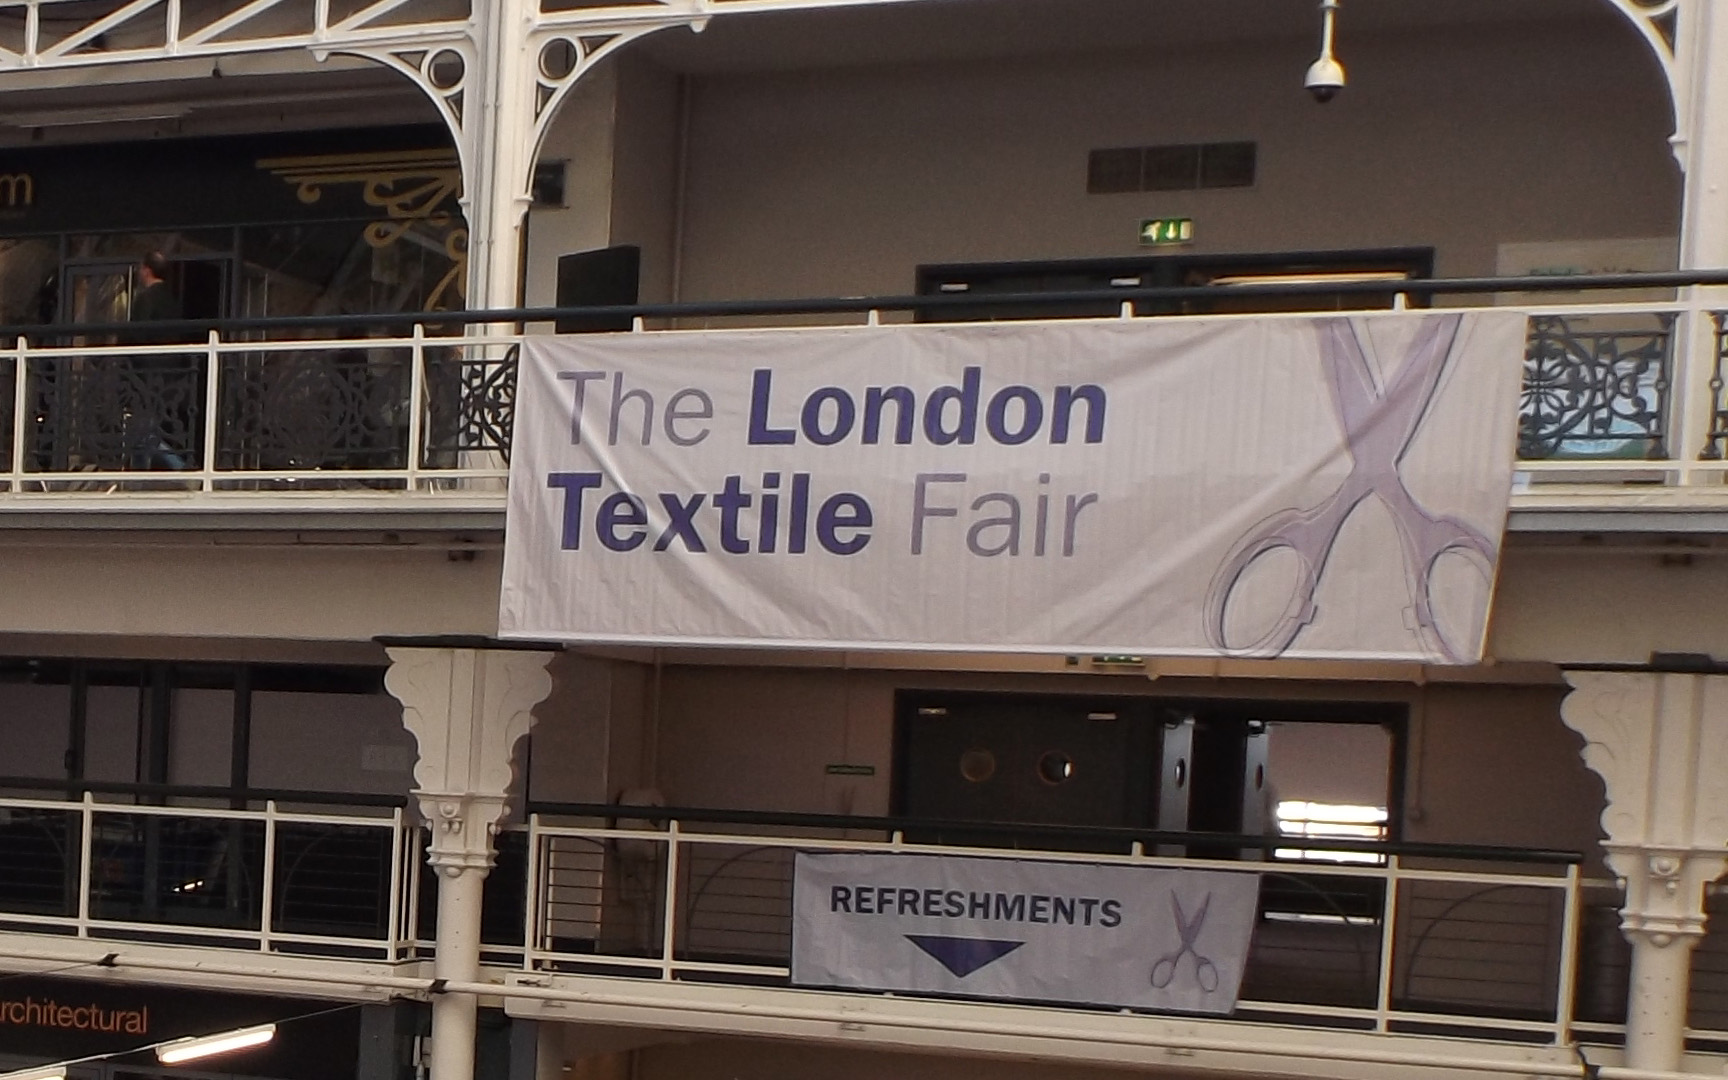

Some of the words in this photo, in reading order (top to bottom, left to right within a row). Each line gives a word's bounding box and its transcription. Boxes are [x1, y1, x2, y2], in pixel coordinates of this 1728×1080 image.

[556, 371, 713, 447] The
[747, 366, 1107, 446] London
[547, 472, 873, 555] Textile
[910, 472, 1099, 557] Fair
[830, 885, 1122, 927] REFRESHMENTS
